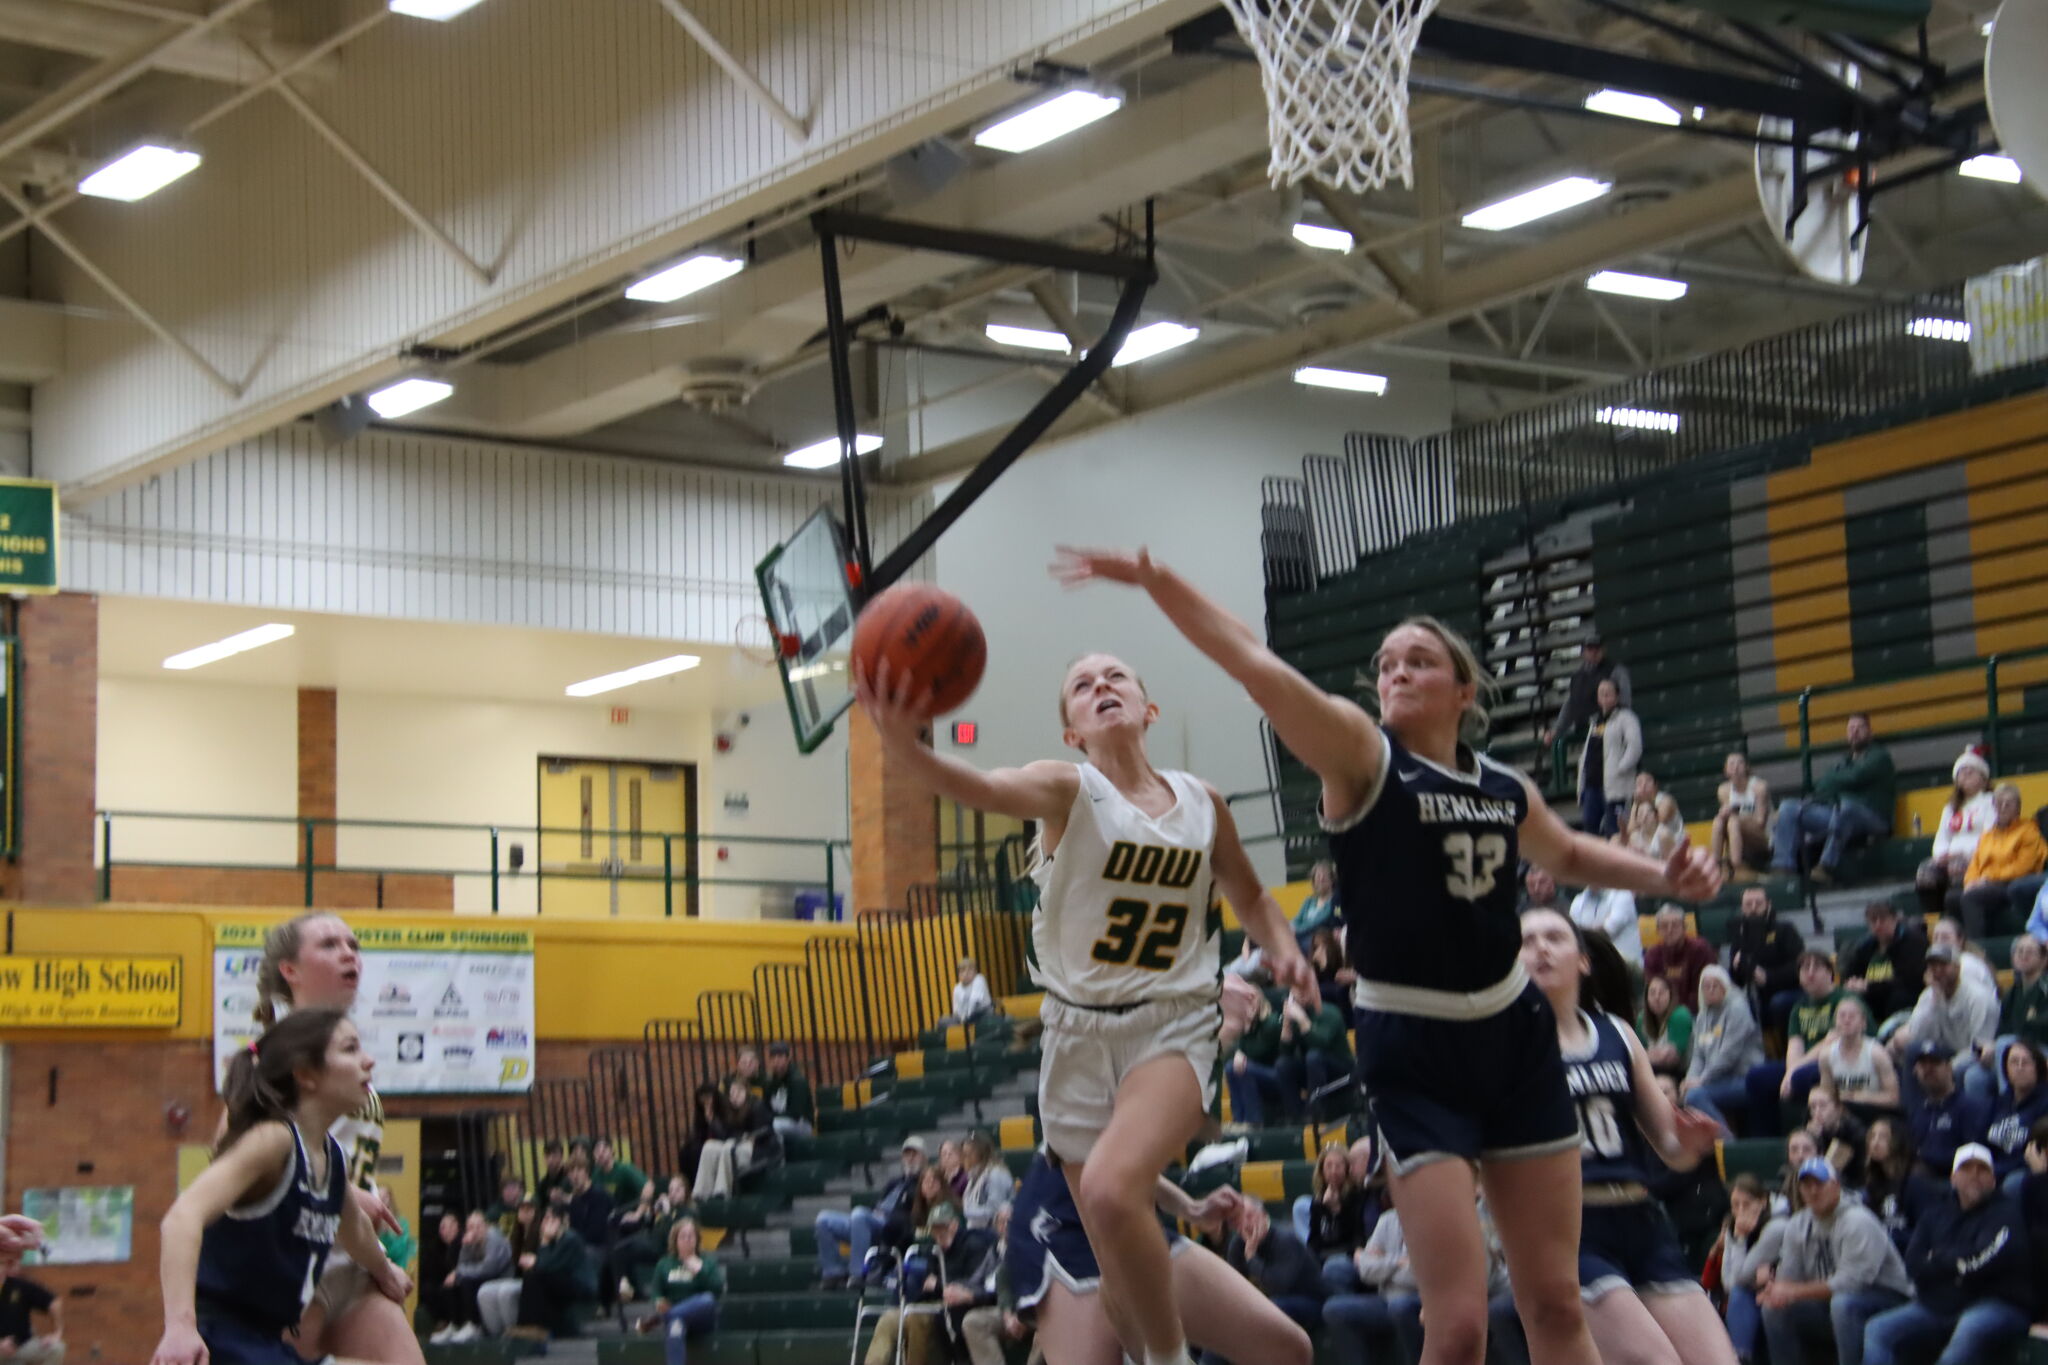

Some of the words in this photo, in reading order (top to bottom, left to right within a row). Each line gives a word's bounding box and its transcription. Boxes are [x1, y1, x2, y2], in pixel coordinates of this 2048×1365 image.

[1102, 840, 1203, 889] DOW
[1443, 831, 1507, 901] 33
[1090, 896, 1190, 973] 32
[33, 961, 91, 998] High
[99, 961, 176, 993] School
